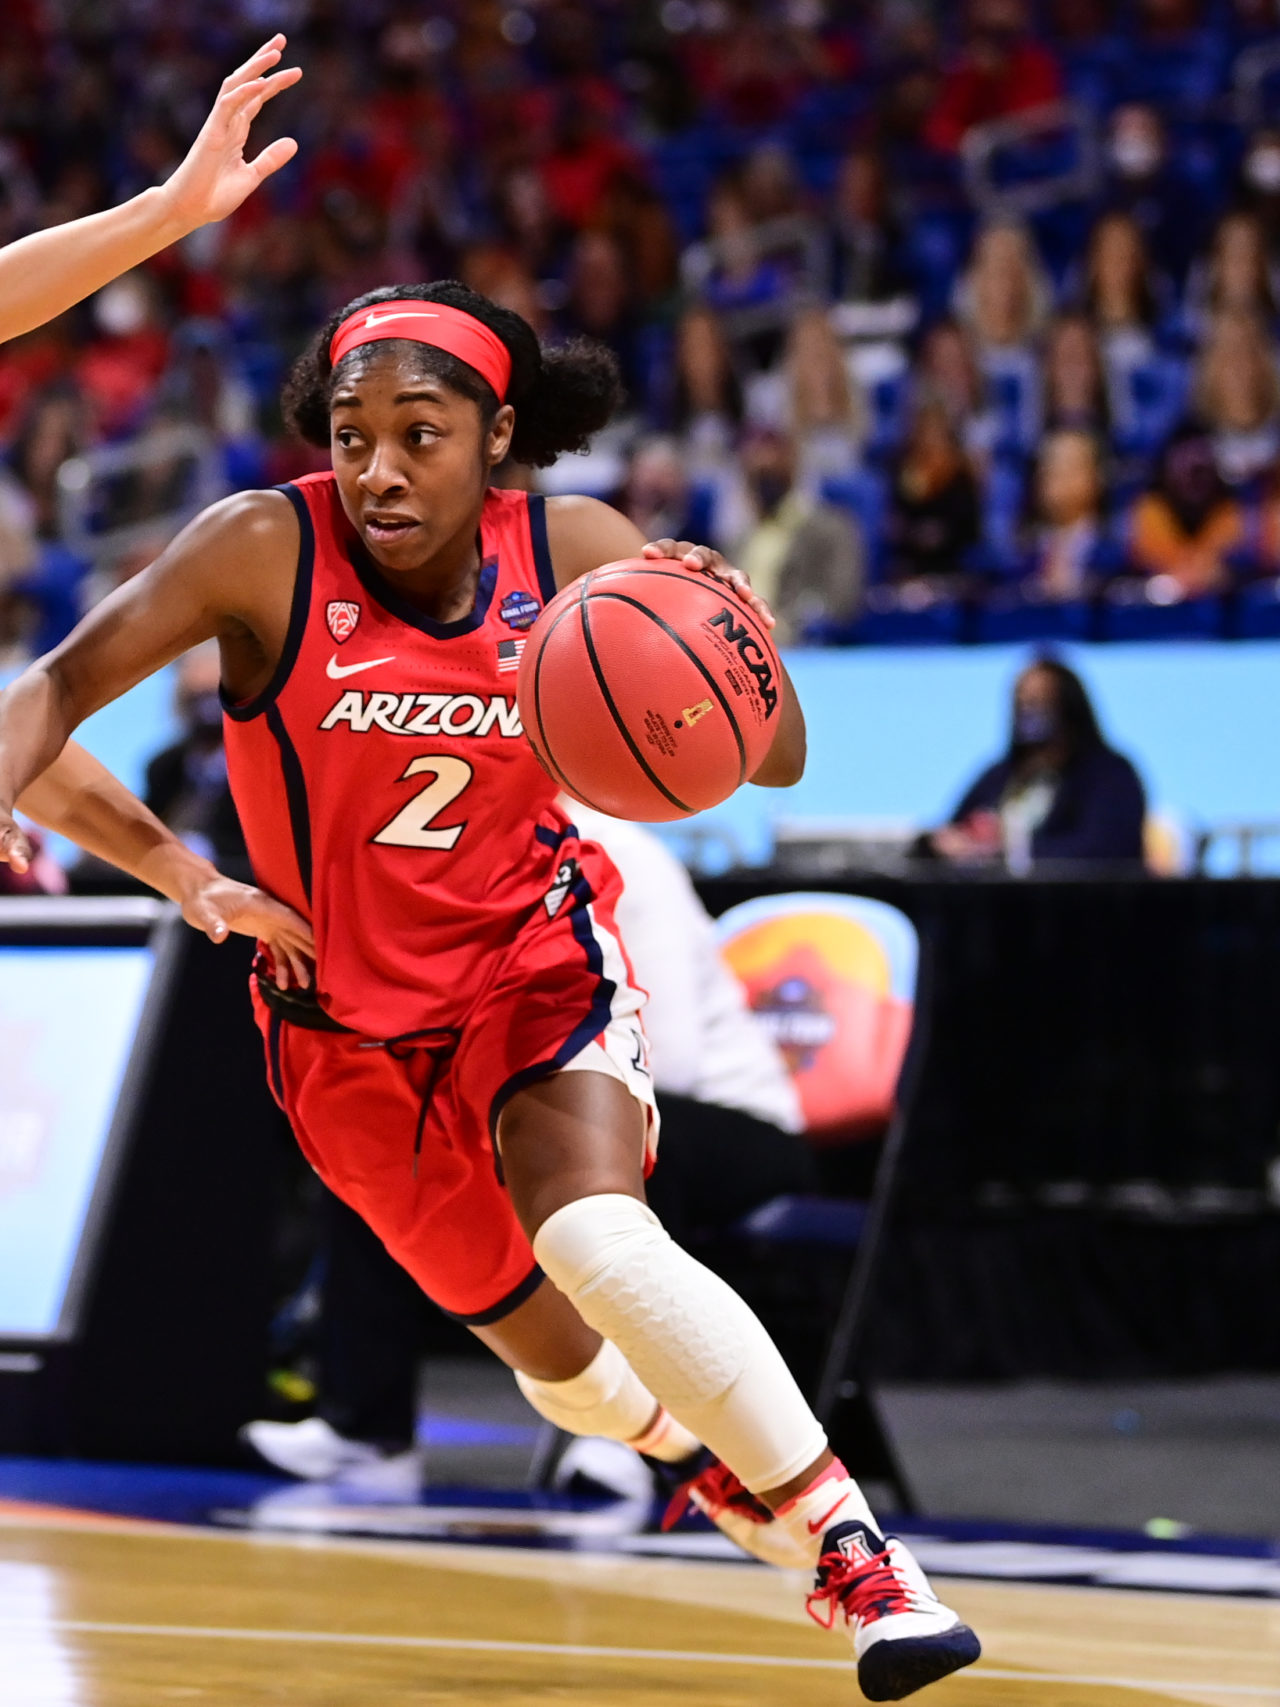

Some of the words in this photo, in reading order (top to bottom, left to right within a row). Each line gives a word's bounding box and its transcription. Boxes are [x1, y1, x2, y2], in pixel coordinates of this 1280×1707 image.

[332, 618, 351, 635] 12
[707, 607, 778, 721] NCAA
[317, 689, 524, 738] ARIZON
[368, 753, 475, 851] 2
